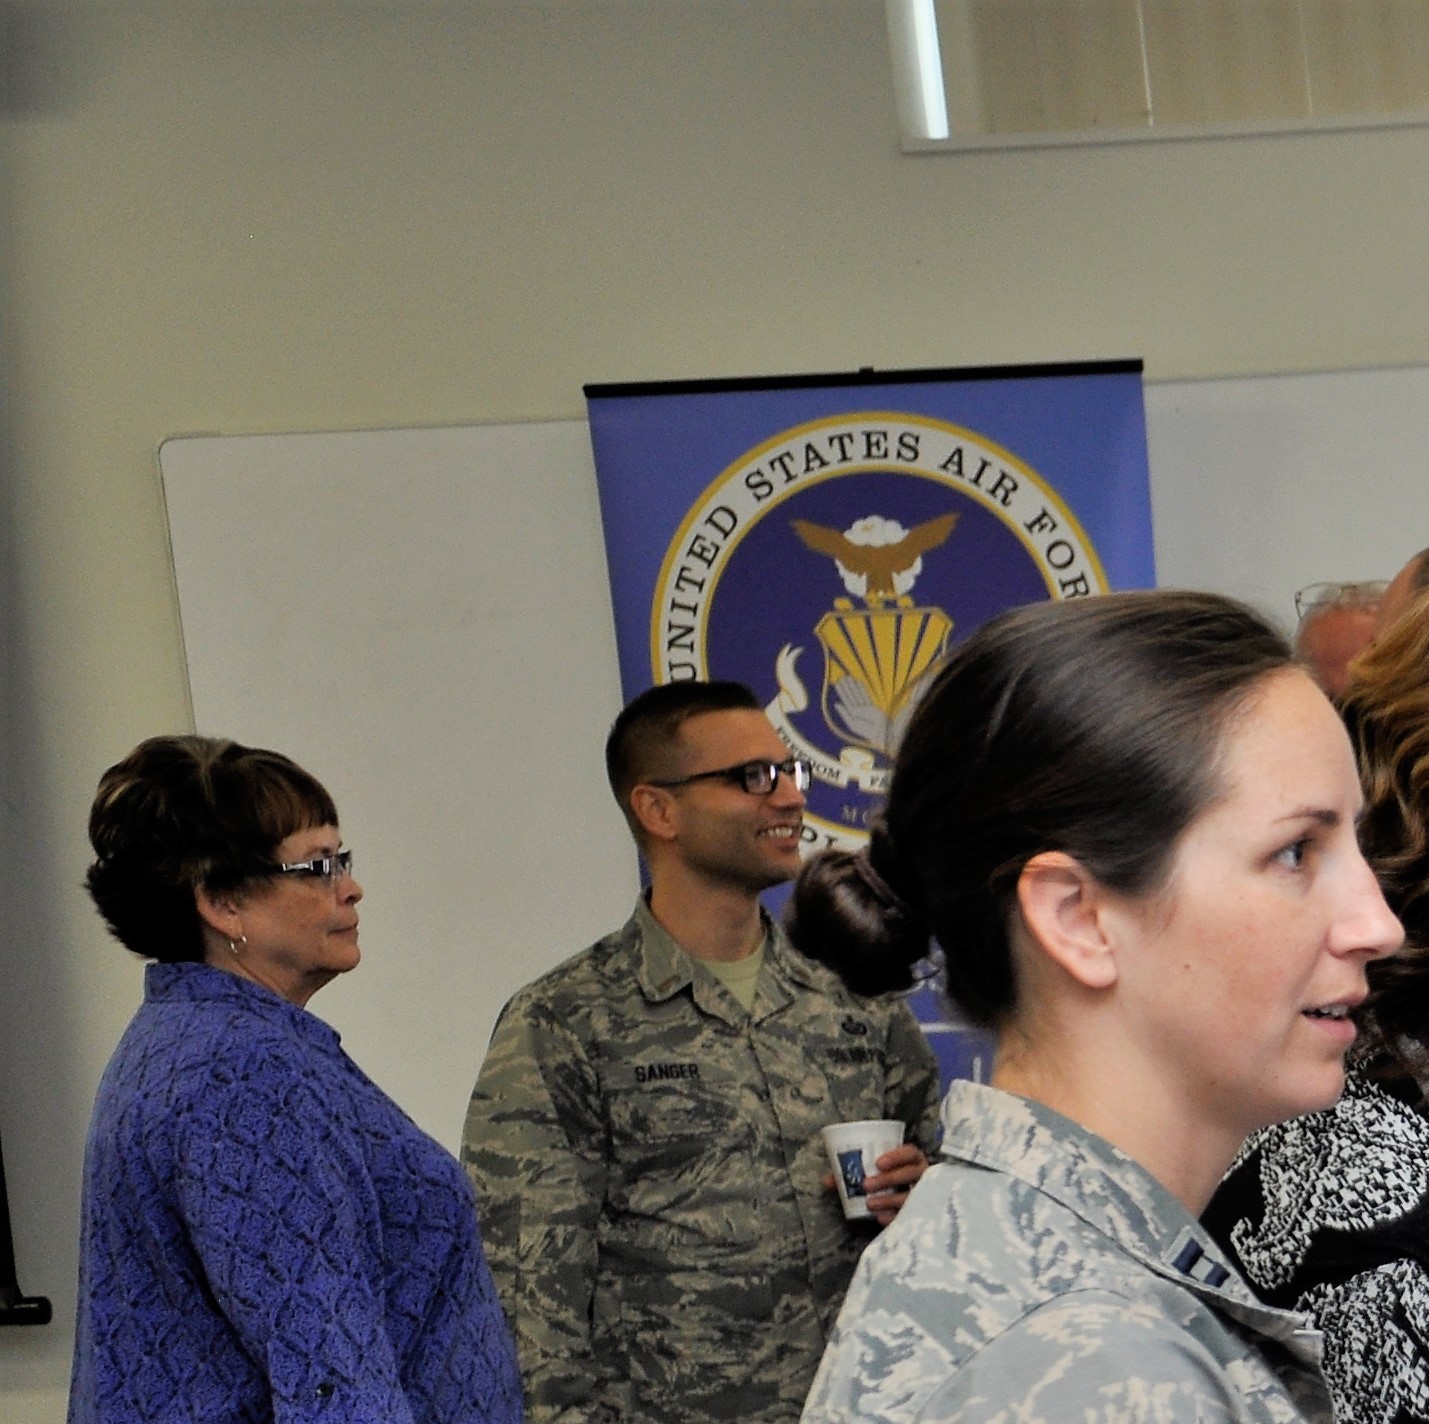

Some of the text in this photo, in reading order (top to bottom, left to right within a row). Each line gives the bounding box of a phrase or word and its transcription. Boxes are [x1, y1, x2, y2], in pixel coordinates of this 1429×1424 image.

[667, 430, 1091, 682] UNITED STATES AIR FOR
